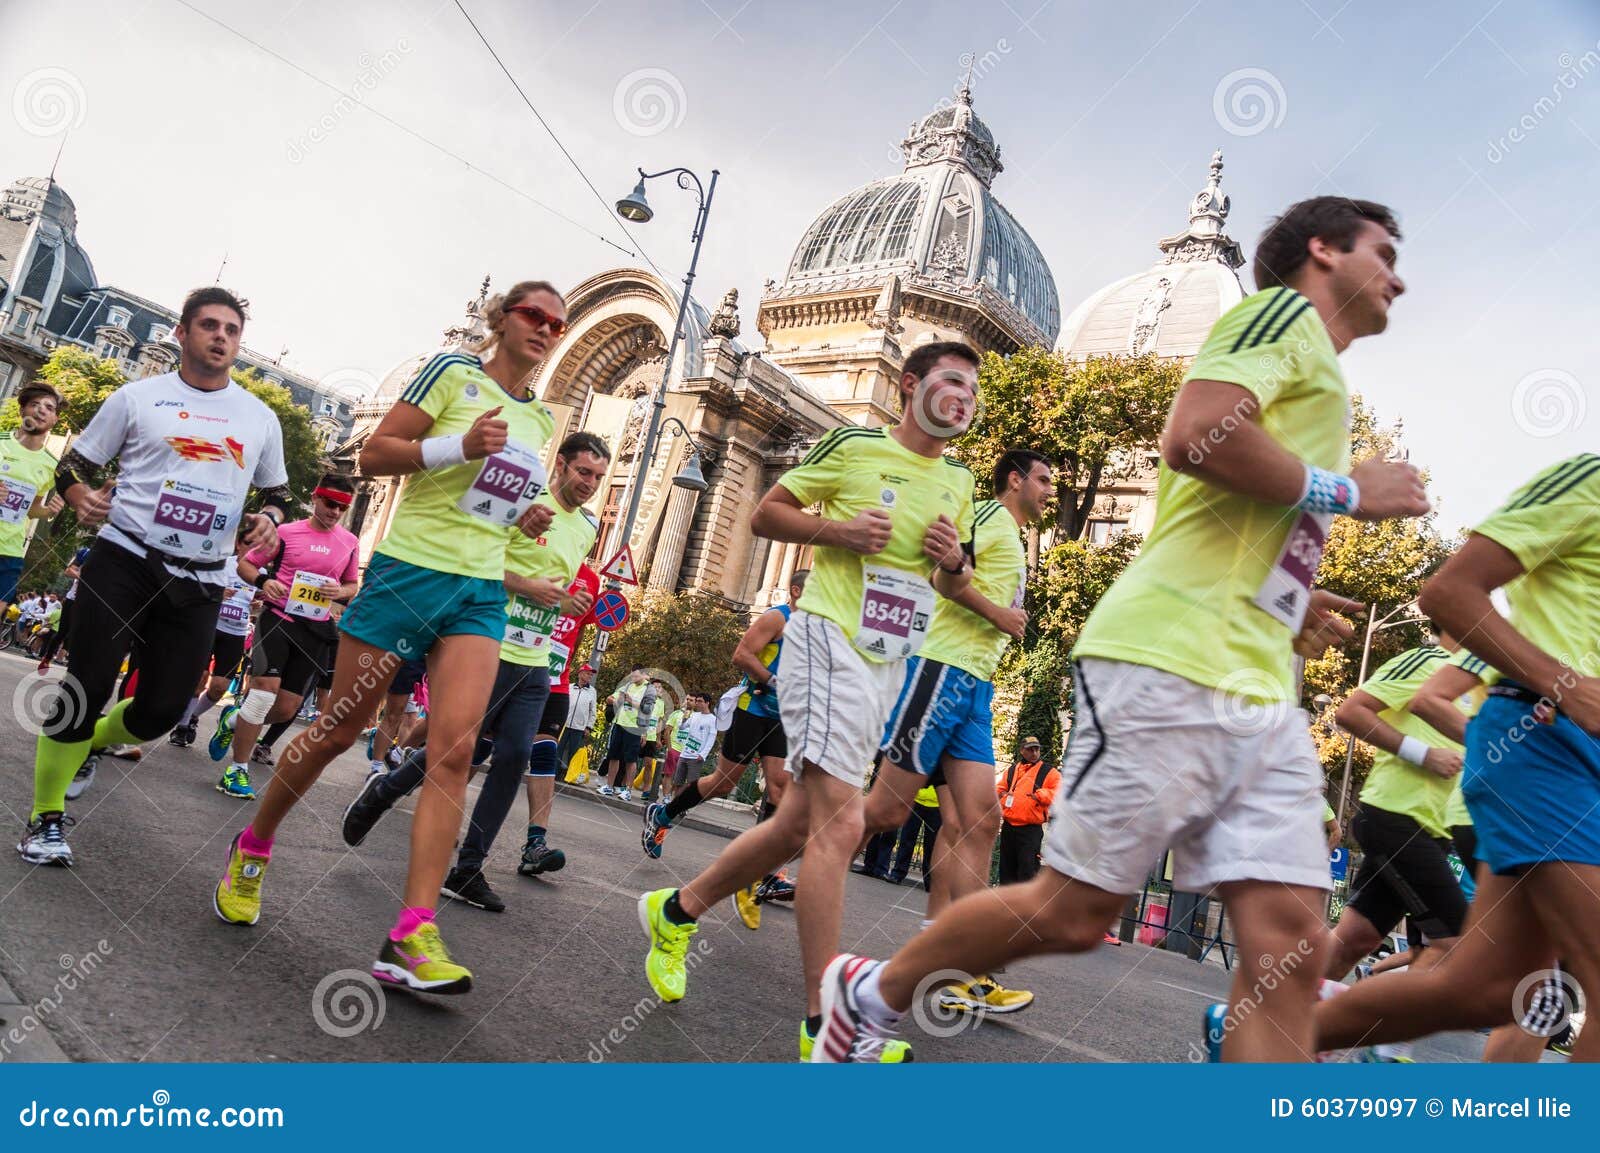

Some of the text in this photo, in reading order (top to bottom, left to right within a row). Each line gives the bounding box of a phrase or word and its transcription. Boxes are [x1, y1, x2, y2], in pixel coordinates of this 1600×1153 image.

[483, 466, 525, 494] 6192
[160, 502, 212, 526] 9357
[310, 544, 331, 555] Eddy
[507, 602, 558, 628] R441/A
[865, 599, 912, 627] 8542
